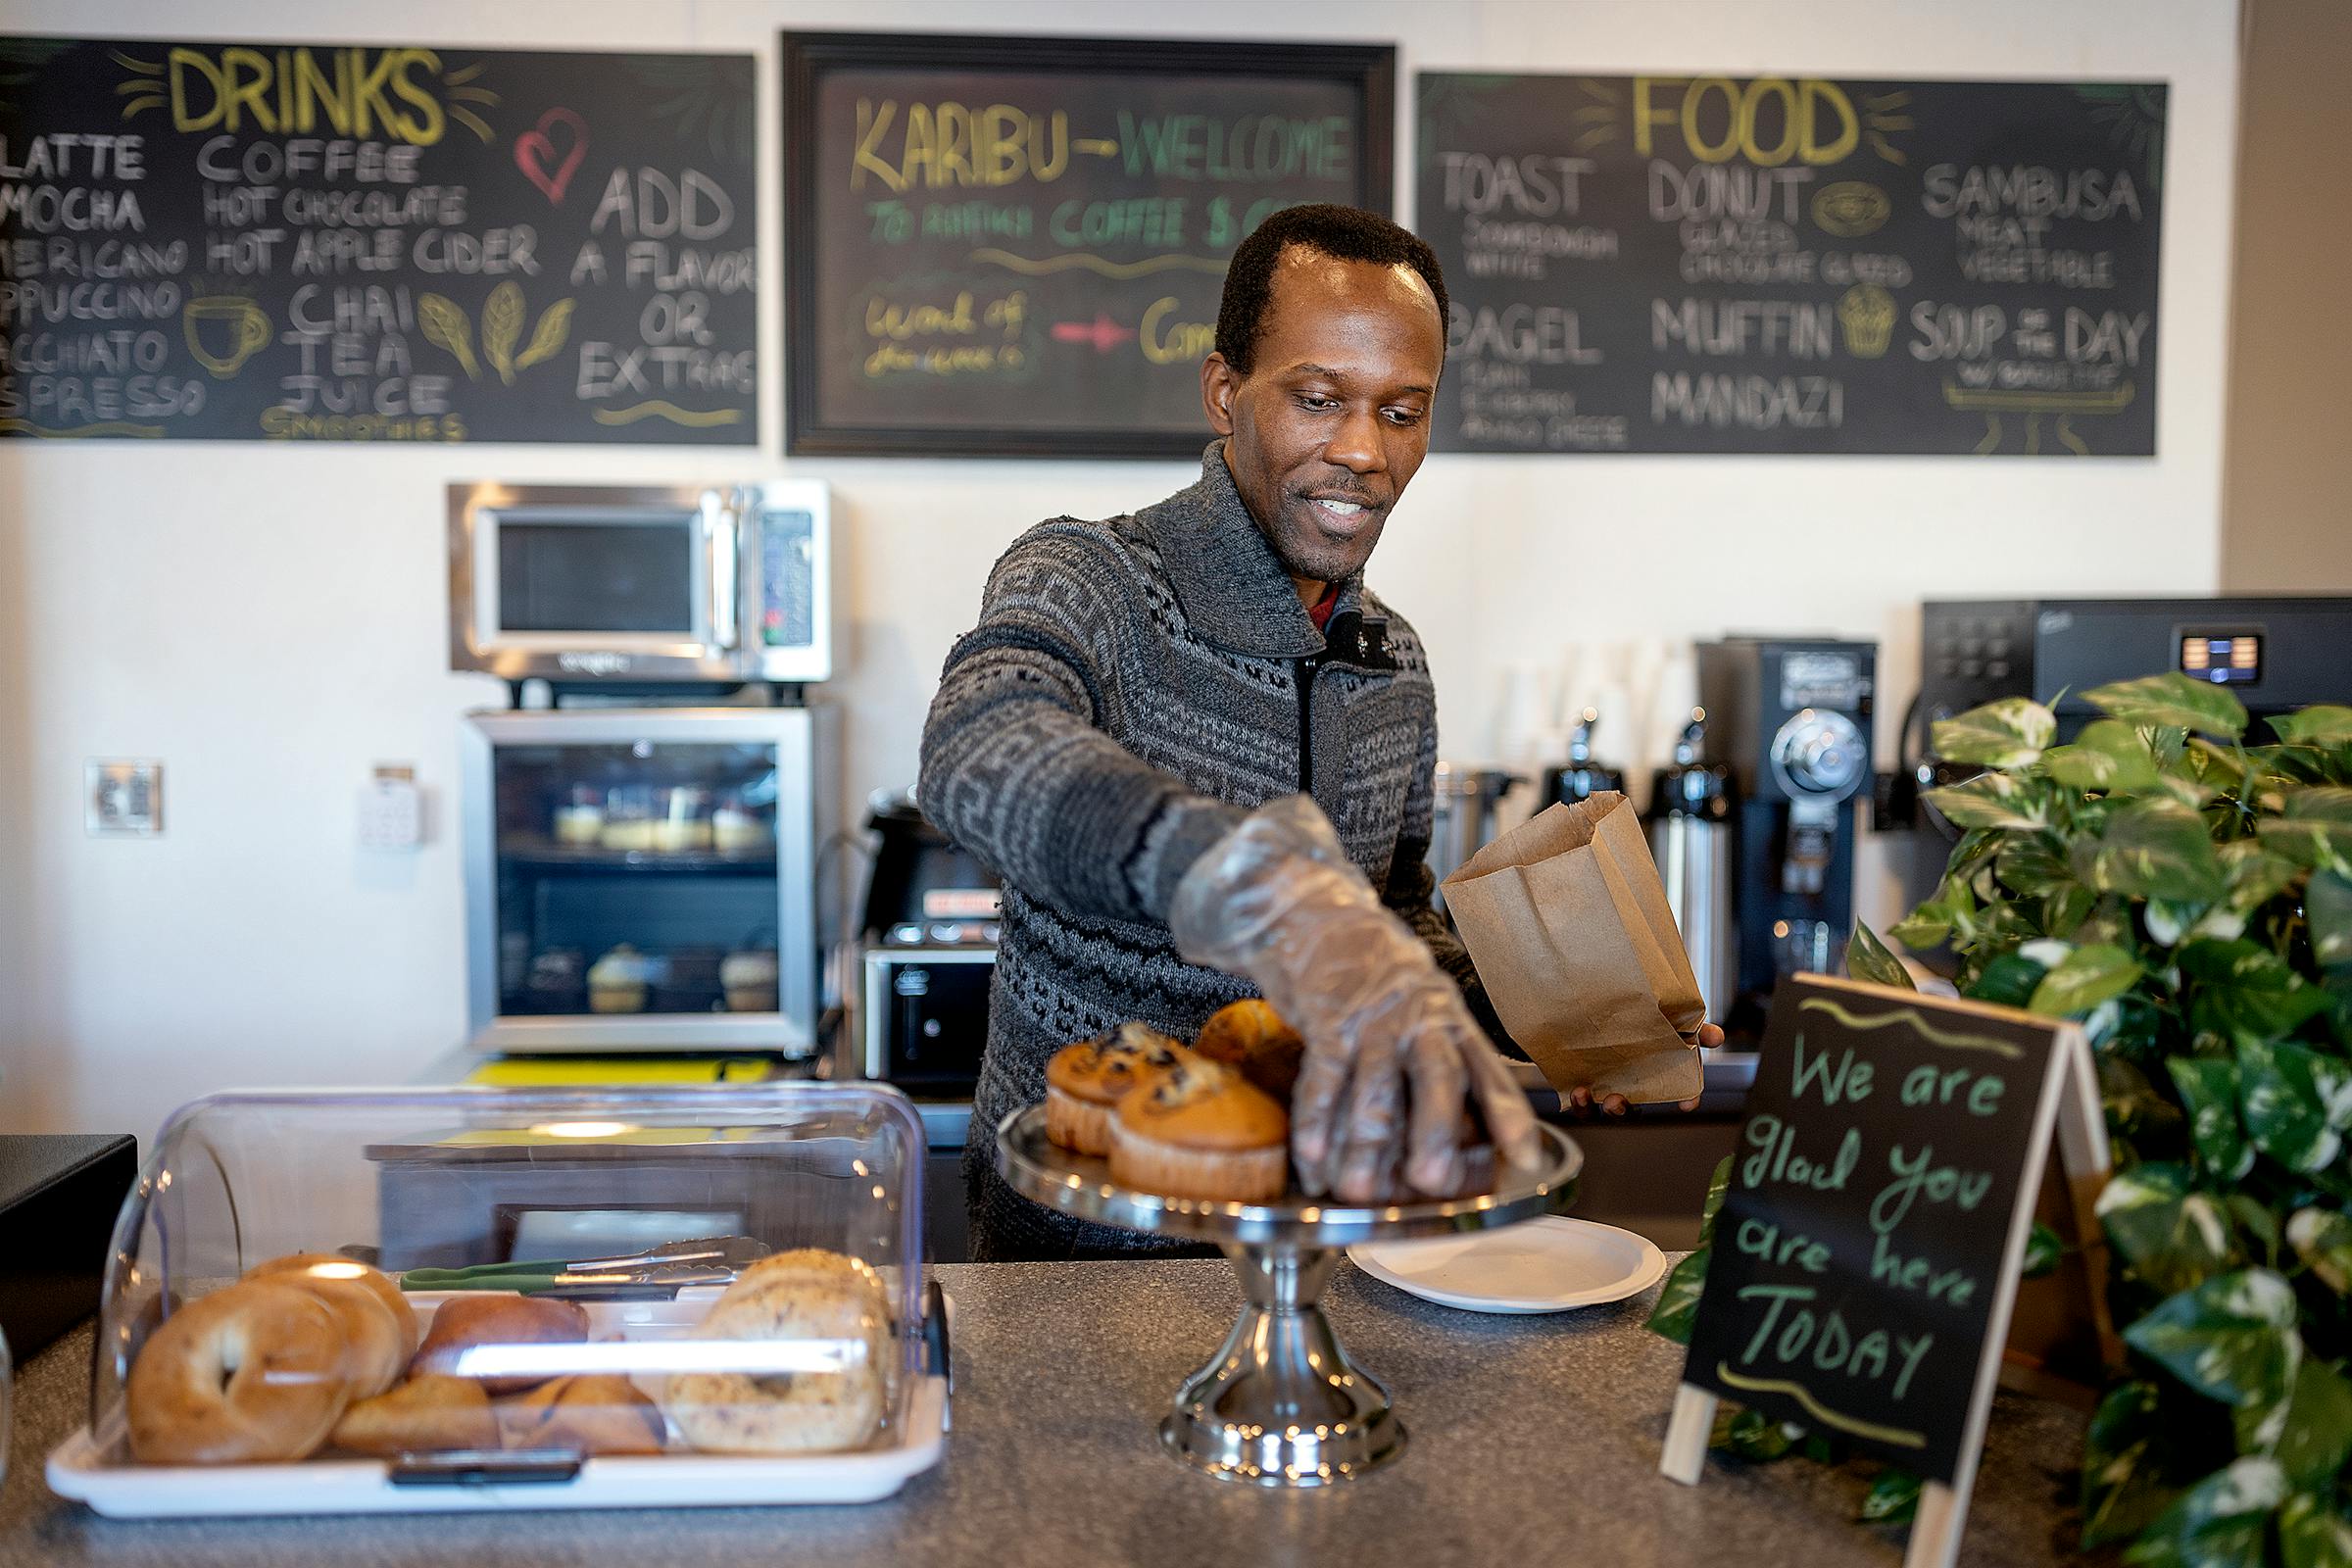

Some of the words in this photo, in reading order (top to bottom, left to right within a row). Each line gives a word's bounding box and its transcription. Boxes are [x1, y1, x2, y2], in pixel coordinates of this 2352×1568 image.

[170, 47, 446, 146] DRINKS
[1632, 74, 1860, 167] FOOD
[0, 133, 146, 179] LATTE
[196, 135, 423, 184] COFFEE
[851, 97, 1069, 193] KARIBU
[1115, 108, 1350, 182] WELCOME
[0, 182, 146, 233] MOCHA
[202, 181, 282, 226] HOT
[281, 184, 468, 226] CHOCOLATE
[590, 165, 735, 241] ADD
[1436, 151, 1597, 218] TOAST
[1646, 158, 1814, 225] DONUT
[1921, 163, 2143, 222] SAMBUSA
[204, 228, 288, 275] HOT
[291, 227, 406, 275] APPLE
[413, 223, 540, 276] CIDER
[1049, 196, 1188, 247] COFFEE
[0, 236, 188, 280] ERICANO
[569, 240, 609, 286] A
[289, 283, 415, 336] CHAI
[639, 290, 715, 347] OR
[1446, 302, 1604, 365] BAGEL
[1650, 297, 1834, 360] MUFFIN
[1909, 300, 2008, 362] SOUP
[2064, 306, 2152, 368] DAY
[280, 329, 412, 377] TEA
[280, 374, 455, 416] JUICE
[1650, 369, 1844, 431] MANDAZI
[1789, 1031, 1876, 1107] We
[1899, 1064, 2006, 1116] are
[1741, 1113, 1863, 1192] glad
[1736, 1218, 1833, 1273] are
[1870, 1233, 1976, 1308] here
